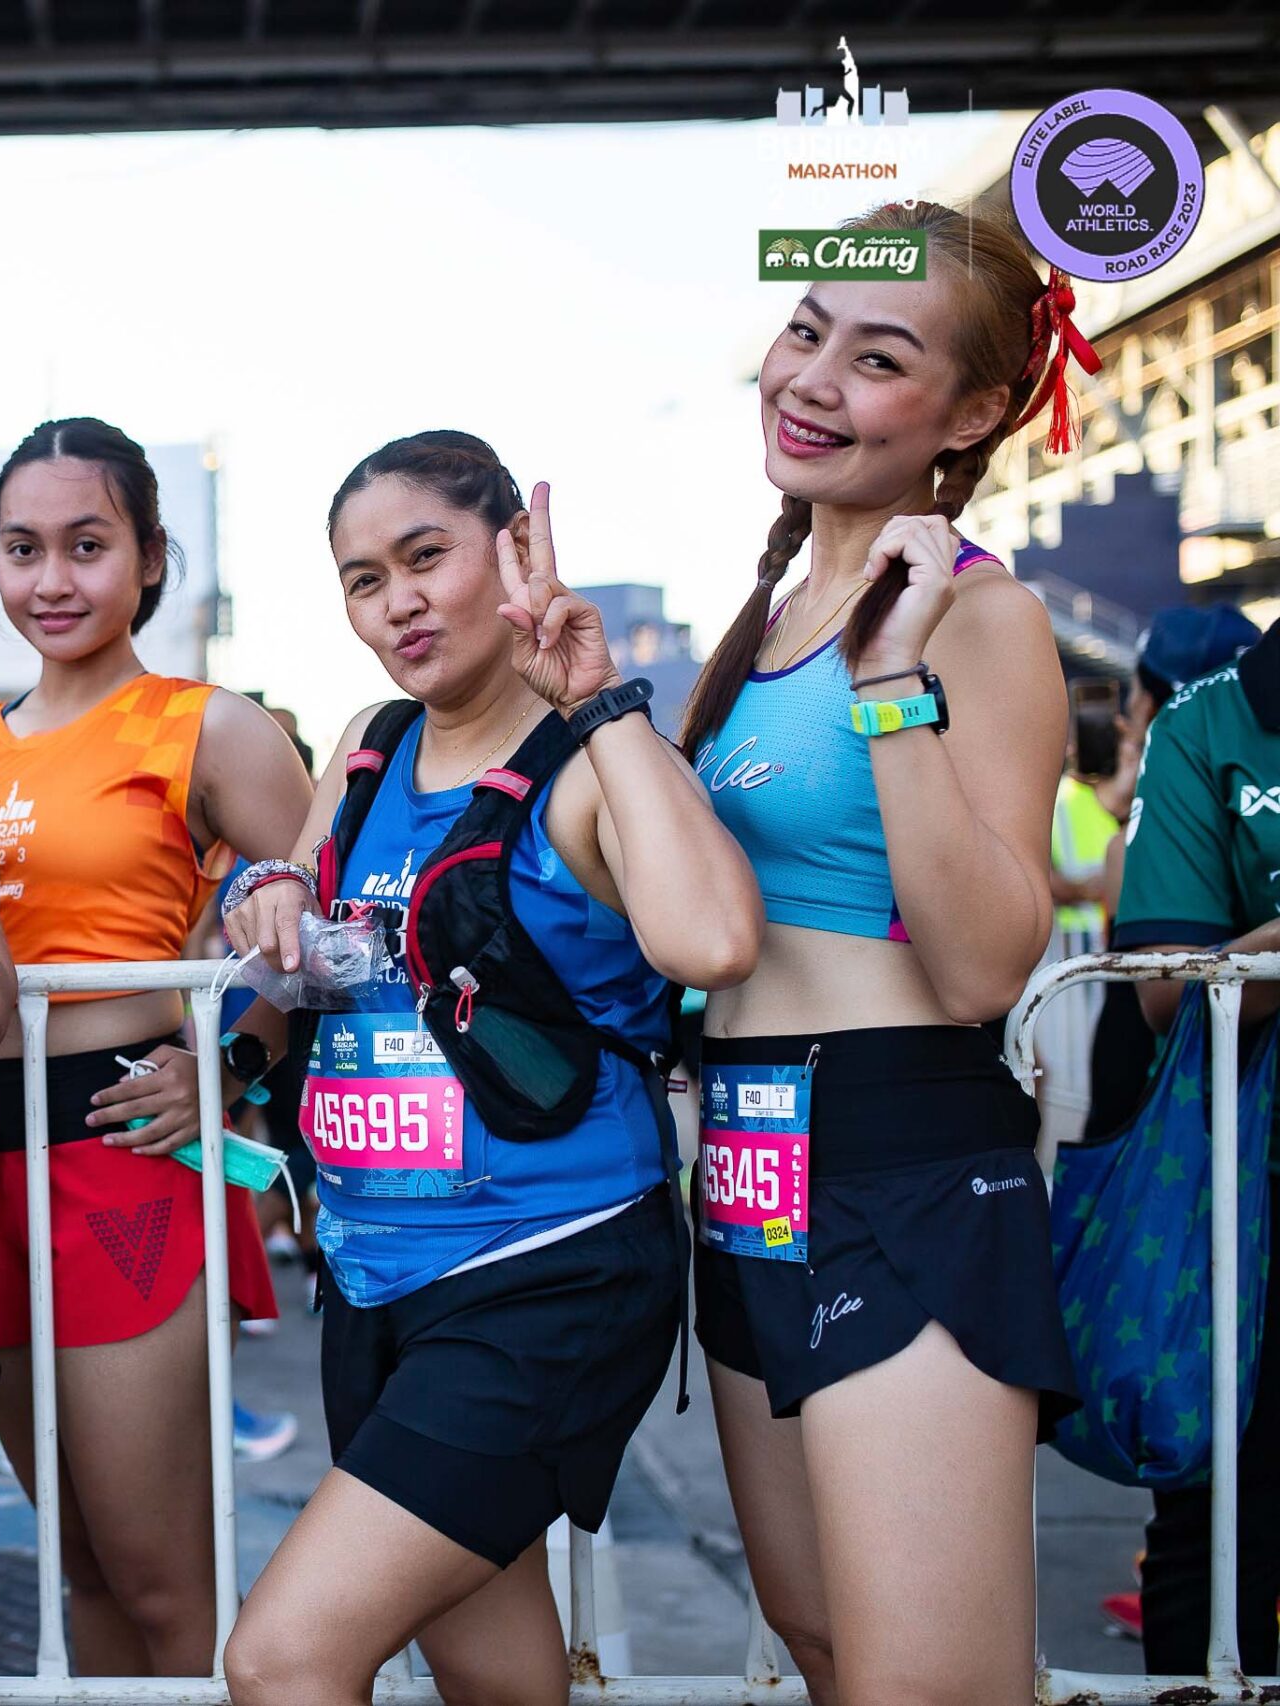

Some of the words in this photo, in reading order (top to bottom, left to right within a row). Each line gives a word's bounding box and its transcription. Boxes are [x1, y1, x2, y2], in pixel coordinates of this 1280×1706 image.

[384, 1038, 404, 1051] F40
[426, 1041, 433, 1052] 4
[745, 1090, 761, 1106] F40
[313, 1091, 429, 1152] 45695
[766, 1226, 790, 1241] 0324
